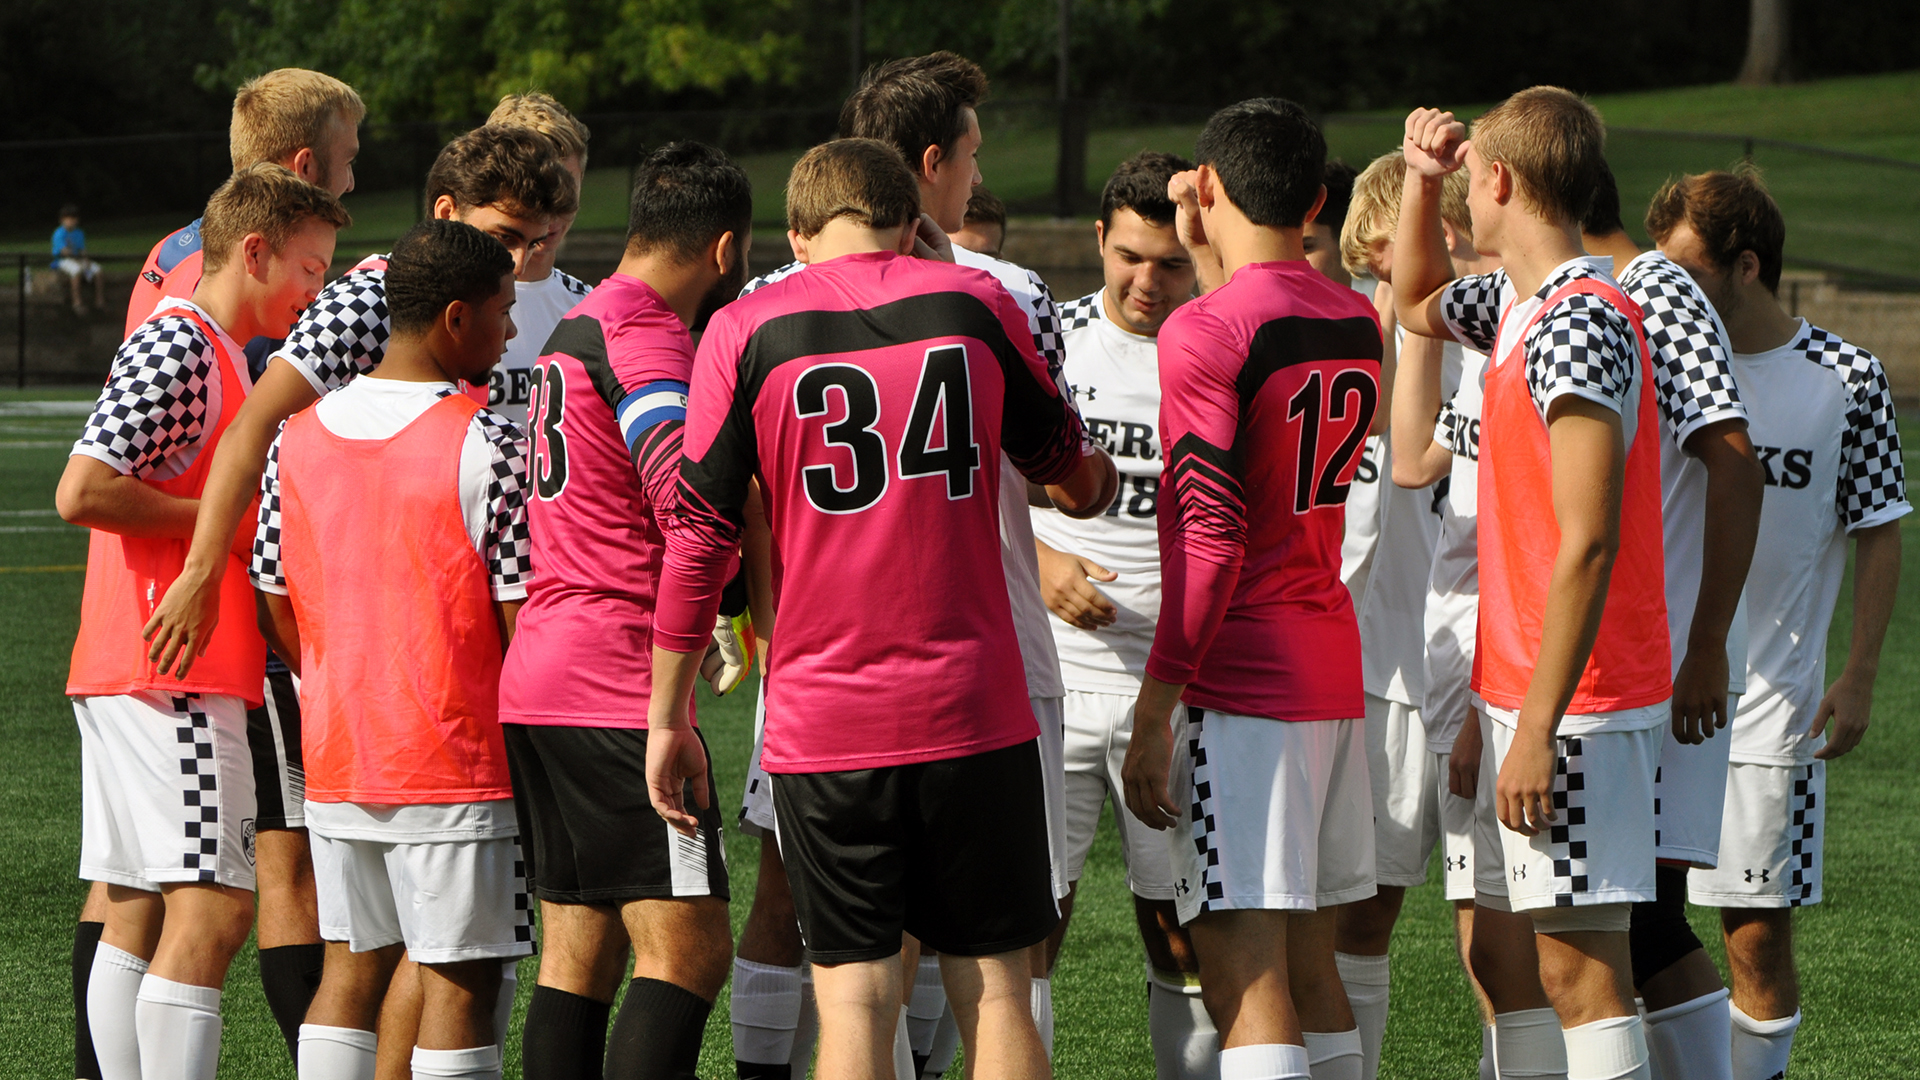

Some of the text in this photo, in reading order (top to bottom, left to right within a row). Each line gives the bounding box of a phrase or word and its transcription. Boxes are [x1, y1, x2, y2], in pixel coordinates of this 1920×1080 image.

[793, 343, 980, 515] 34
[1286, 367, 1379, 516] 12
[1753, 445, 1814, 490] KS
